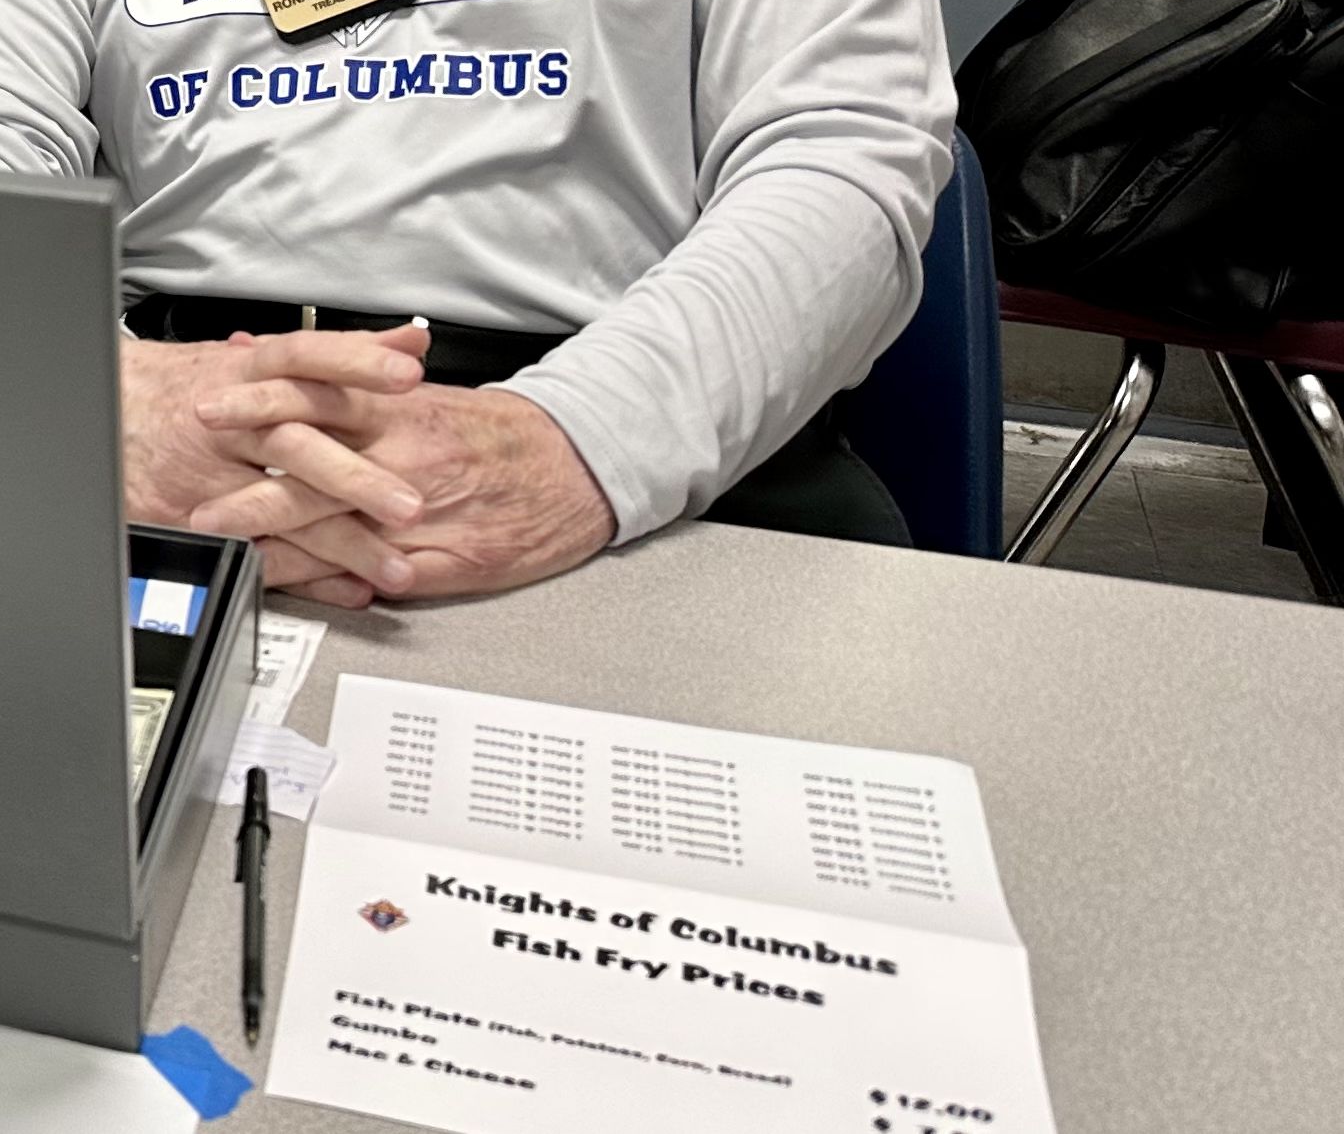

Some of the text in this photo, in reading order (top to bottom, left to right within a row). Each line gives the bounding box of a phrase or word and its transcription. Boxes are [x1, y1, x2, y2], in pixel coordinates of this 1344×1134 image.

[147, 50, 573, 119] OF COLUMBUS
[425, 874, 901, 978] Knights of Columbus
[492, 930, 826, 1008] Fish Fry Prices
[331, 1015, 437, 1045] Gumbo
[335, 990, 395, 1012] Fish
[404, 1003, 481, 1027] Plate
[551, 1033, 651, 1062] Potatoes,
[328, 1039, 537, 1090] Mac & Cheese
